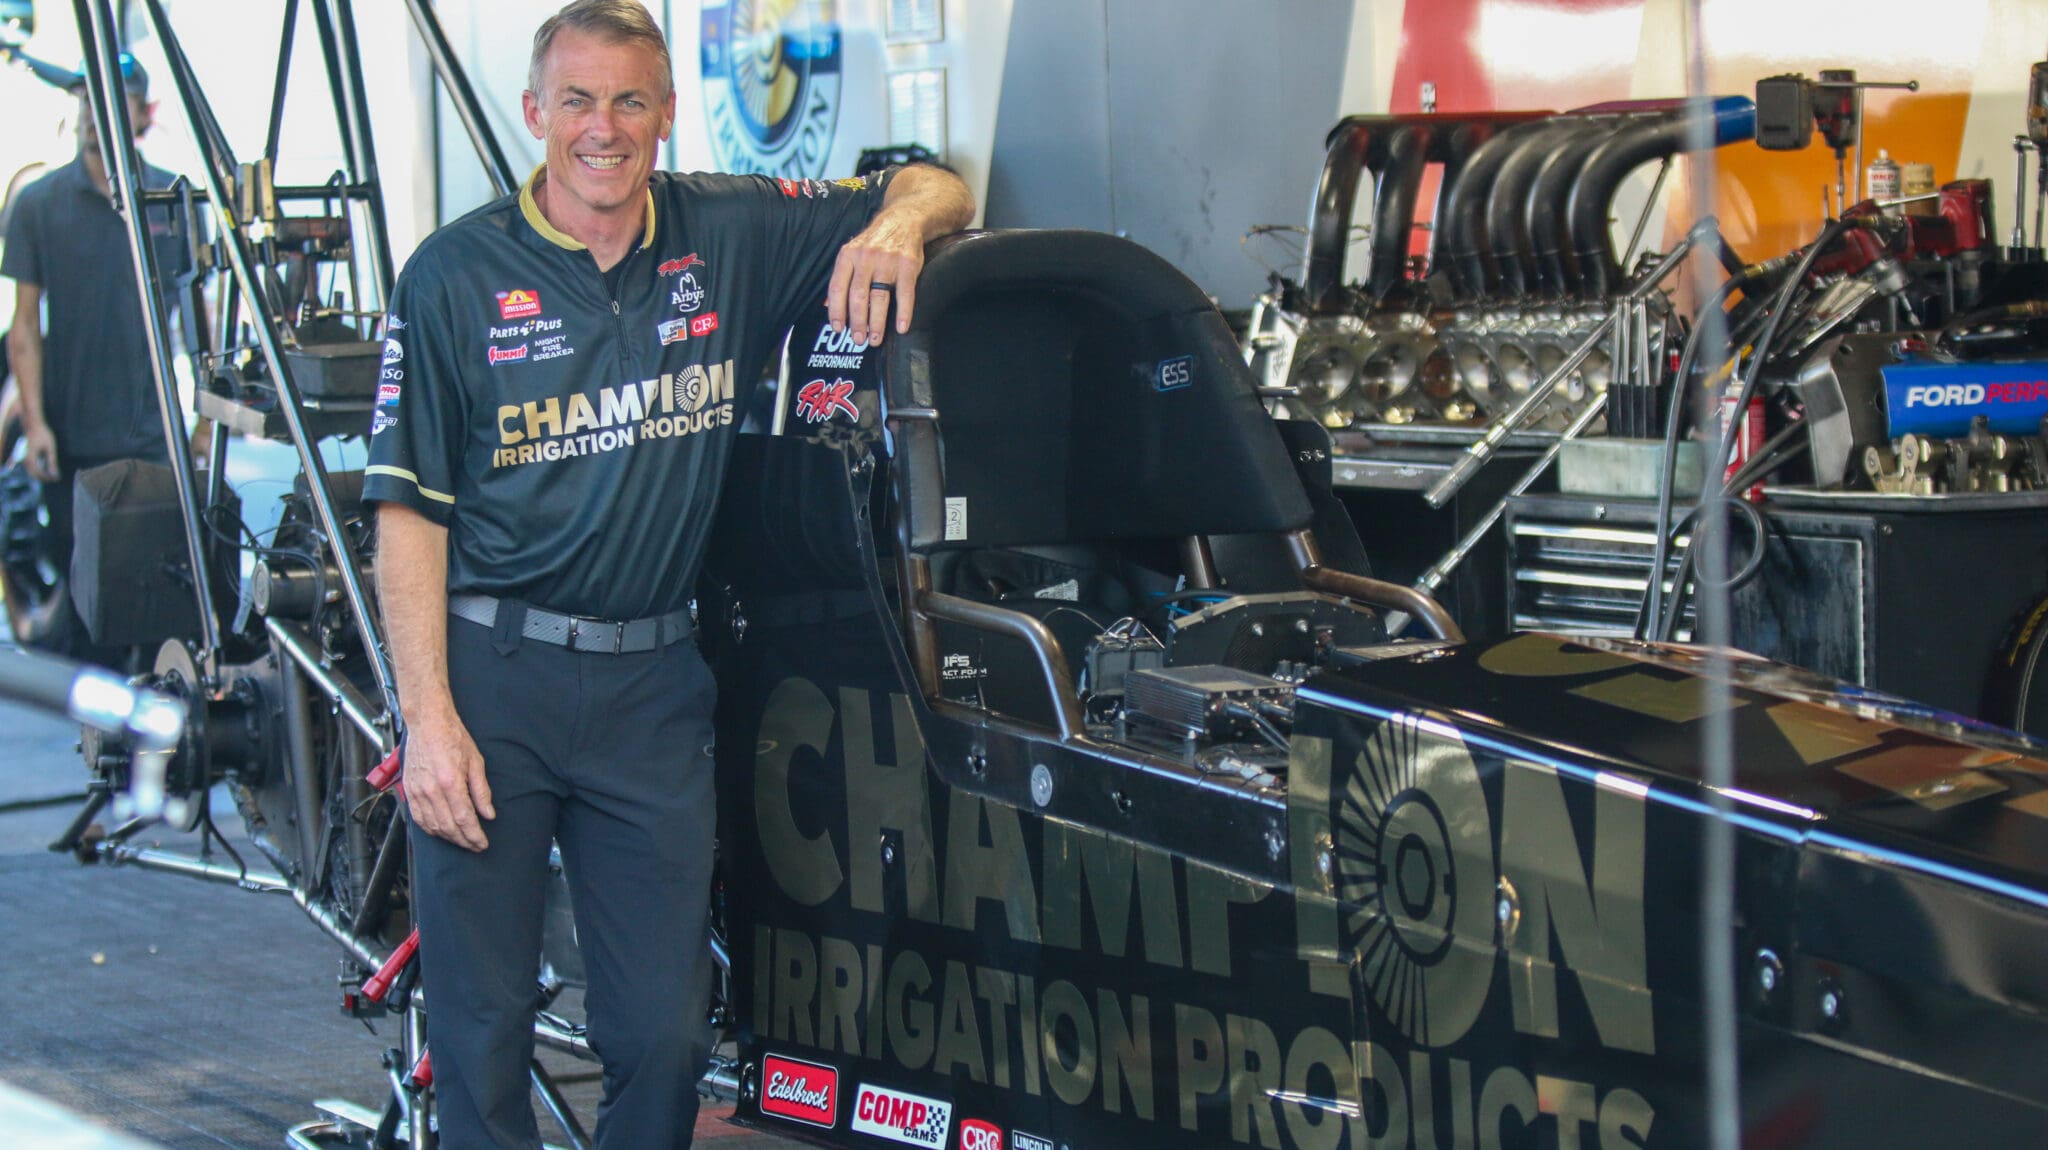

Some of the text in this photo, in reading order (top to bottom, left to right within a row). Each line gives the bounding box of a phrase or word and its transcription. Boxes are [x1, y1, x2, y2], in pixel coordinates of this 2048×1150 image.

[489, 318, 562, 339] PARTS PLUS
[693, 316, 715, 333] CR
[534, 335, 567, 347] MIGHTY
[542, 343, 562, 353] FIRE
[532, 348, 575, 362] BREAKER
[807, 354, 864, 370] PERFORMANCE
[1906, 384, 1986, 408] FORD
[493, 403, 734, 469] IRRIGATION RODUCTS
[753, 925, 1154, 1120] IRRIGATION
[767, 1071, 829, 1111] Edelbrock
[858, 1090, 927, 1129] COMP
[903, 1126, 938, 1143] CAMS
[963, 1126, 1000, 1150] CRC
